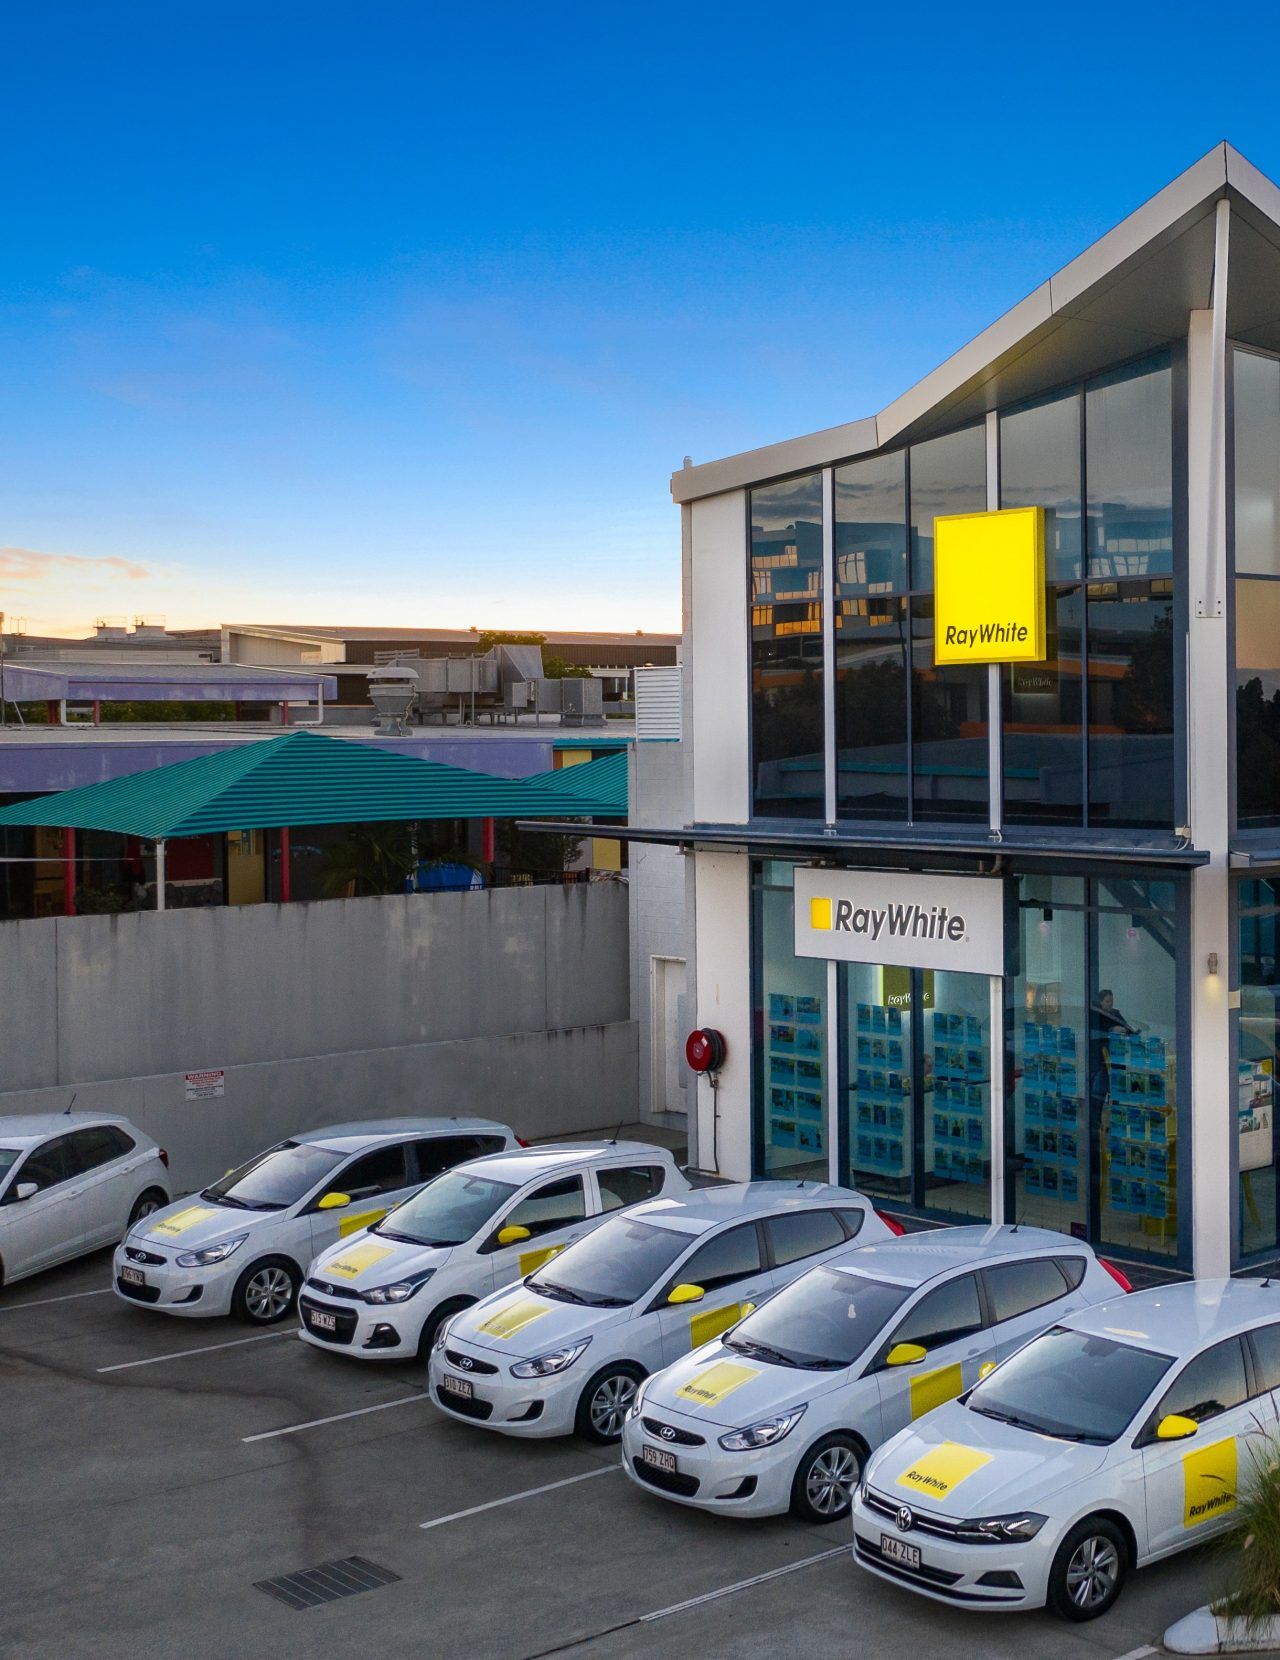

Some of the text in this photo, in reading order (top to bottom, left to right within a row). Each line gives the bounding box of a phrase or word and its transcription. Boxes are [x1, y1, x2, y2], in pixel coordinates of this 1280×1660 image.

[945, 622, 1028, 648] RayWhite
[835, 899, 966, 941] RayWhite
[644, 1447, 657, 1463] 759
[907, 1471, 948, 1491] RayWhite
[901, 1543, 918, 1564] ZLE
